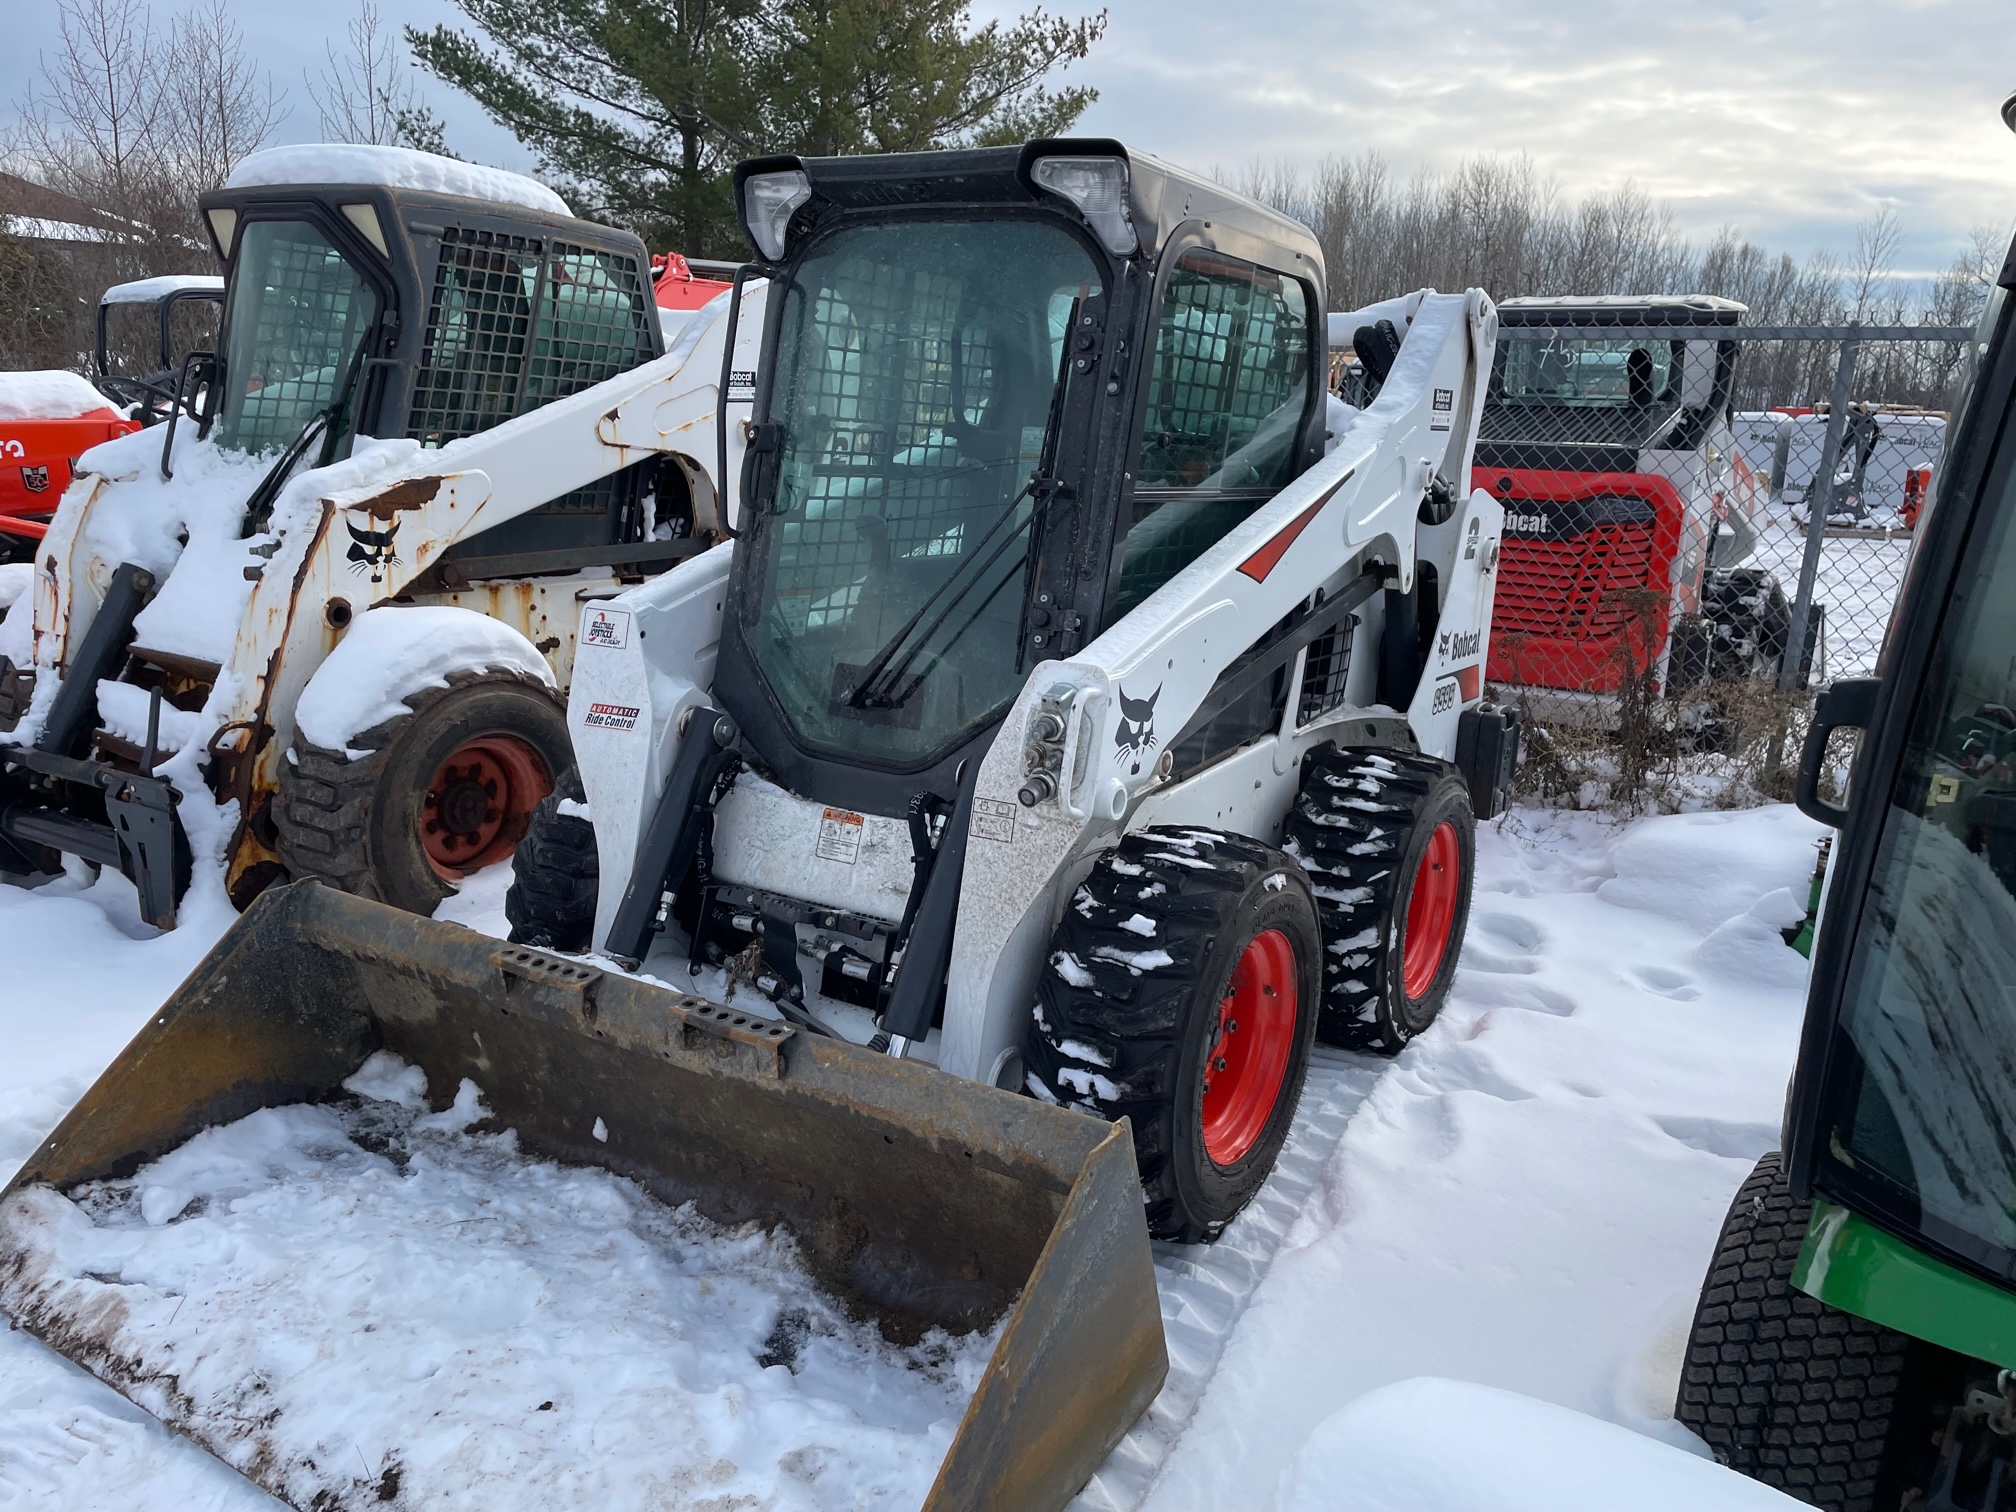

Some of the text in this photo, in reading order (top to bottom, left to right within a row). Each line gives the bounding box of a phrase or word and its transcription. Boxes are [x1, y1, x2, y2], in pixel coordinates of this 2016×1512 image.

[730, 371, 752, 381] Bobcat
[1503, 510, 1548, 533] bcat
[1451, 628, 1481, 661] Bobcat
[1432, 682, 1456, 716] S595
[591, 704, 637, 717] AUTOMATIC
[585, 713, 636, 729] Ride Control
